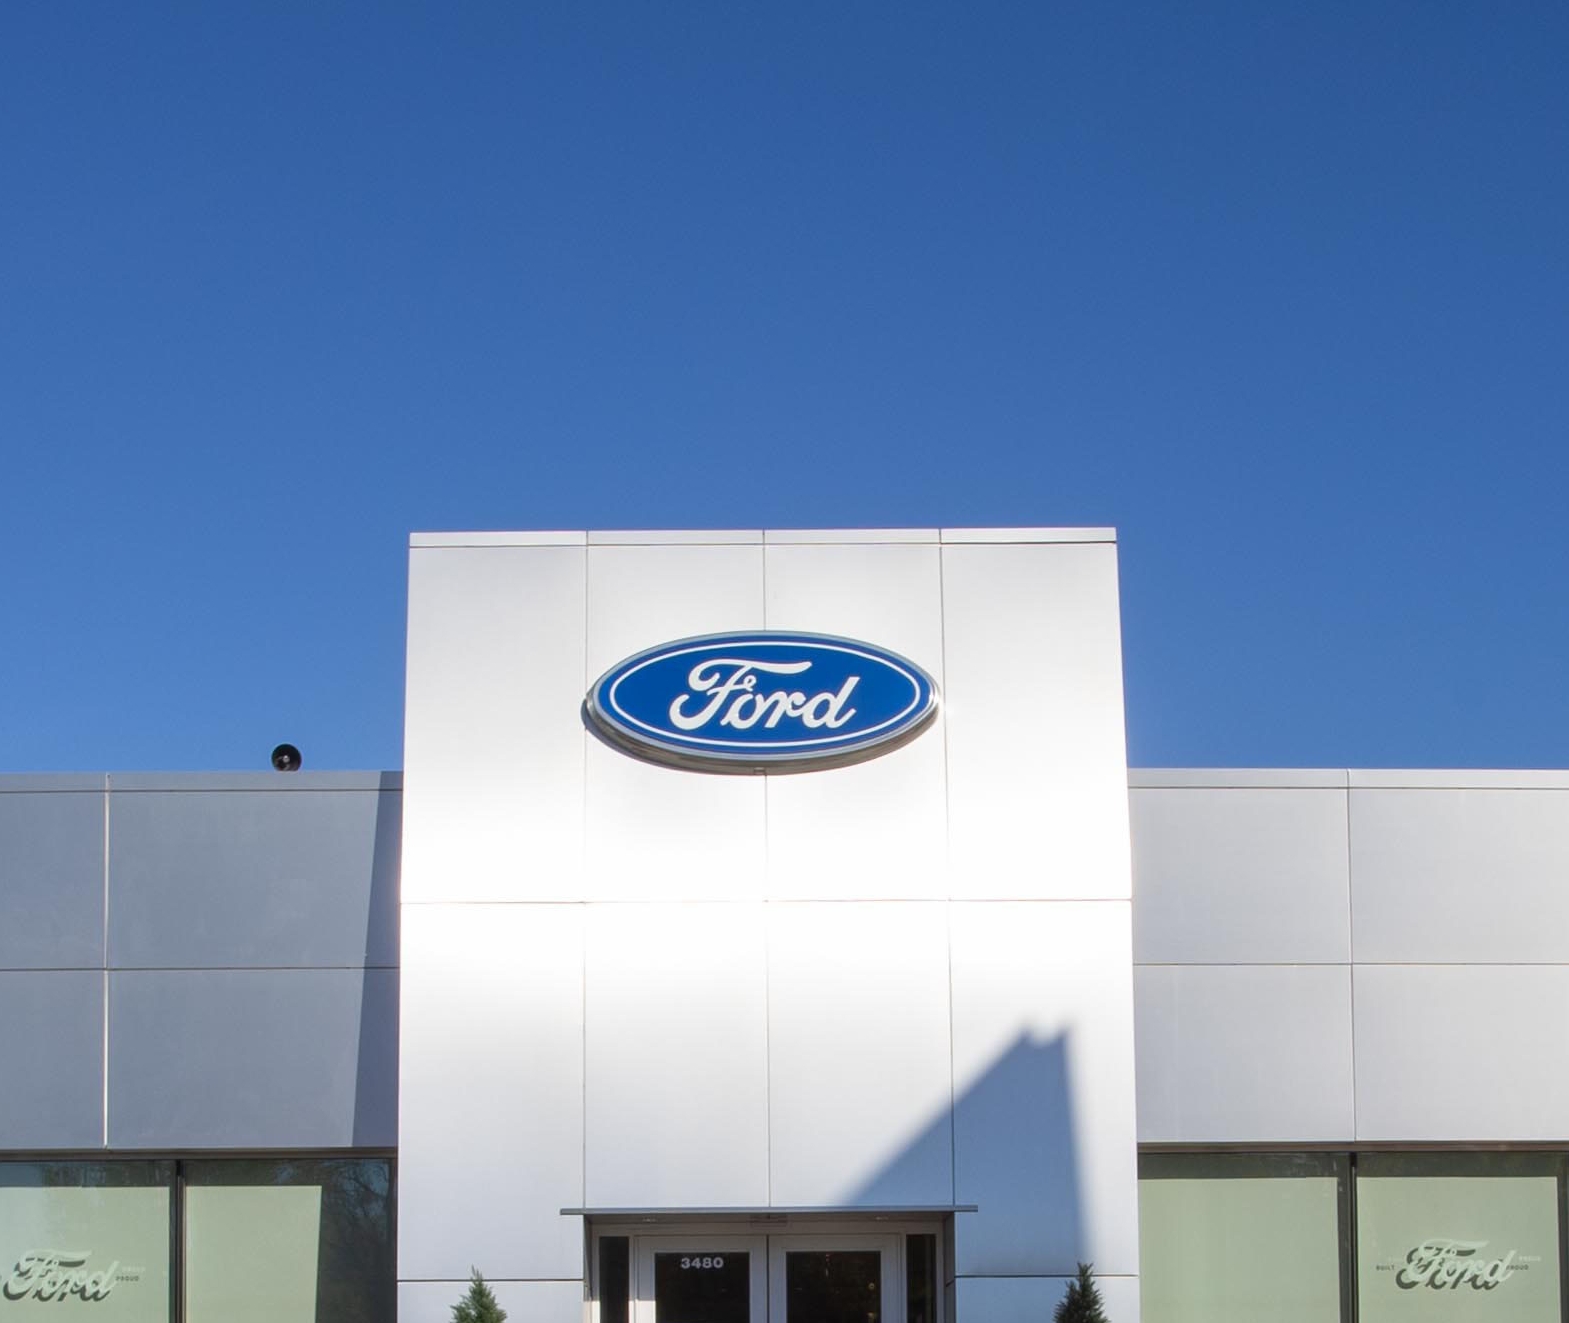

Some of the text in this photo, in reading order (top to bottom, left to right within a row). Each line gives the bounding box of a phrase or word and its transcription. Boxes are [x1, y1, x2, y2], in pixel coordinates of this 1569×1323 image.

[668, 658, 860, 731] Ford
[3, 1249, 120, 1302] Ford
[680, 1257, 725, 1269] 3480
[1396, 1239, 1517, 1291] Ford
